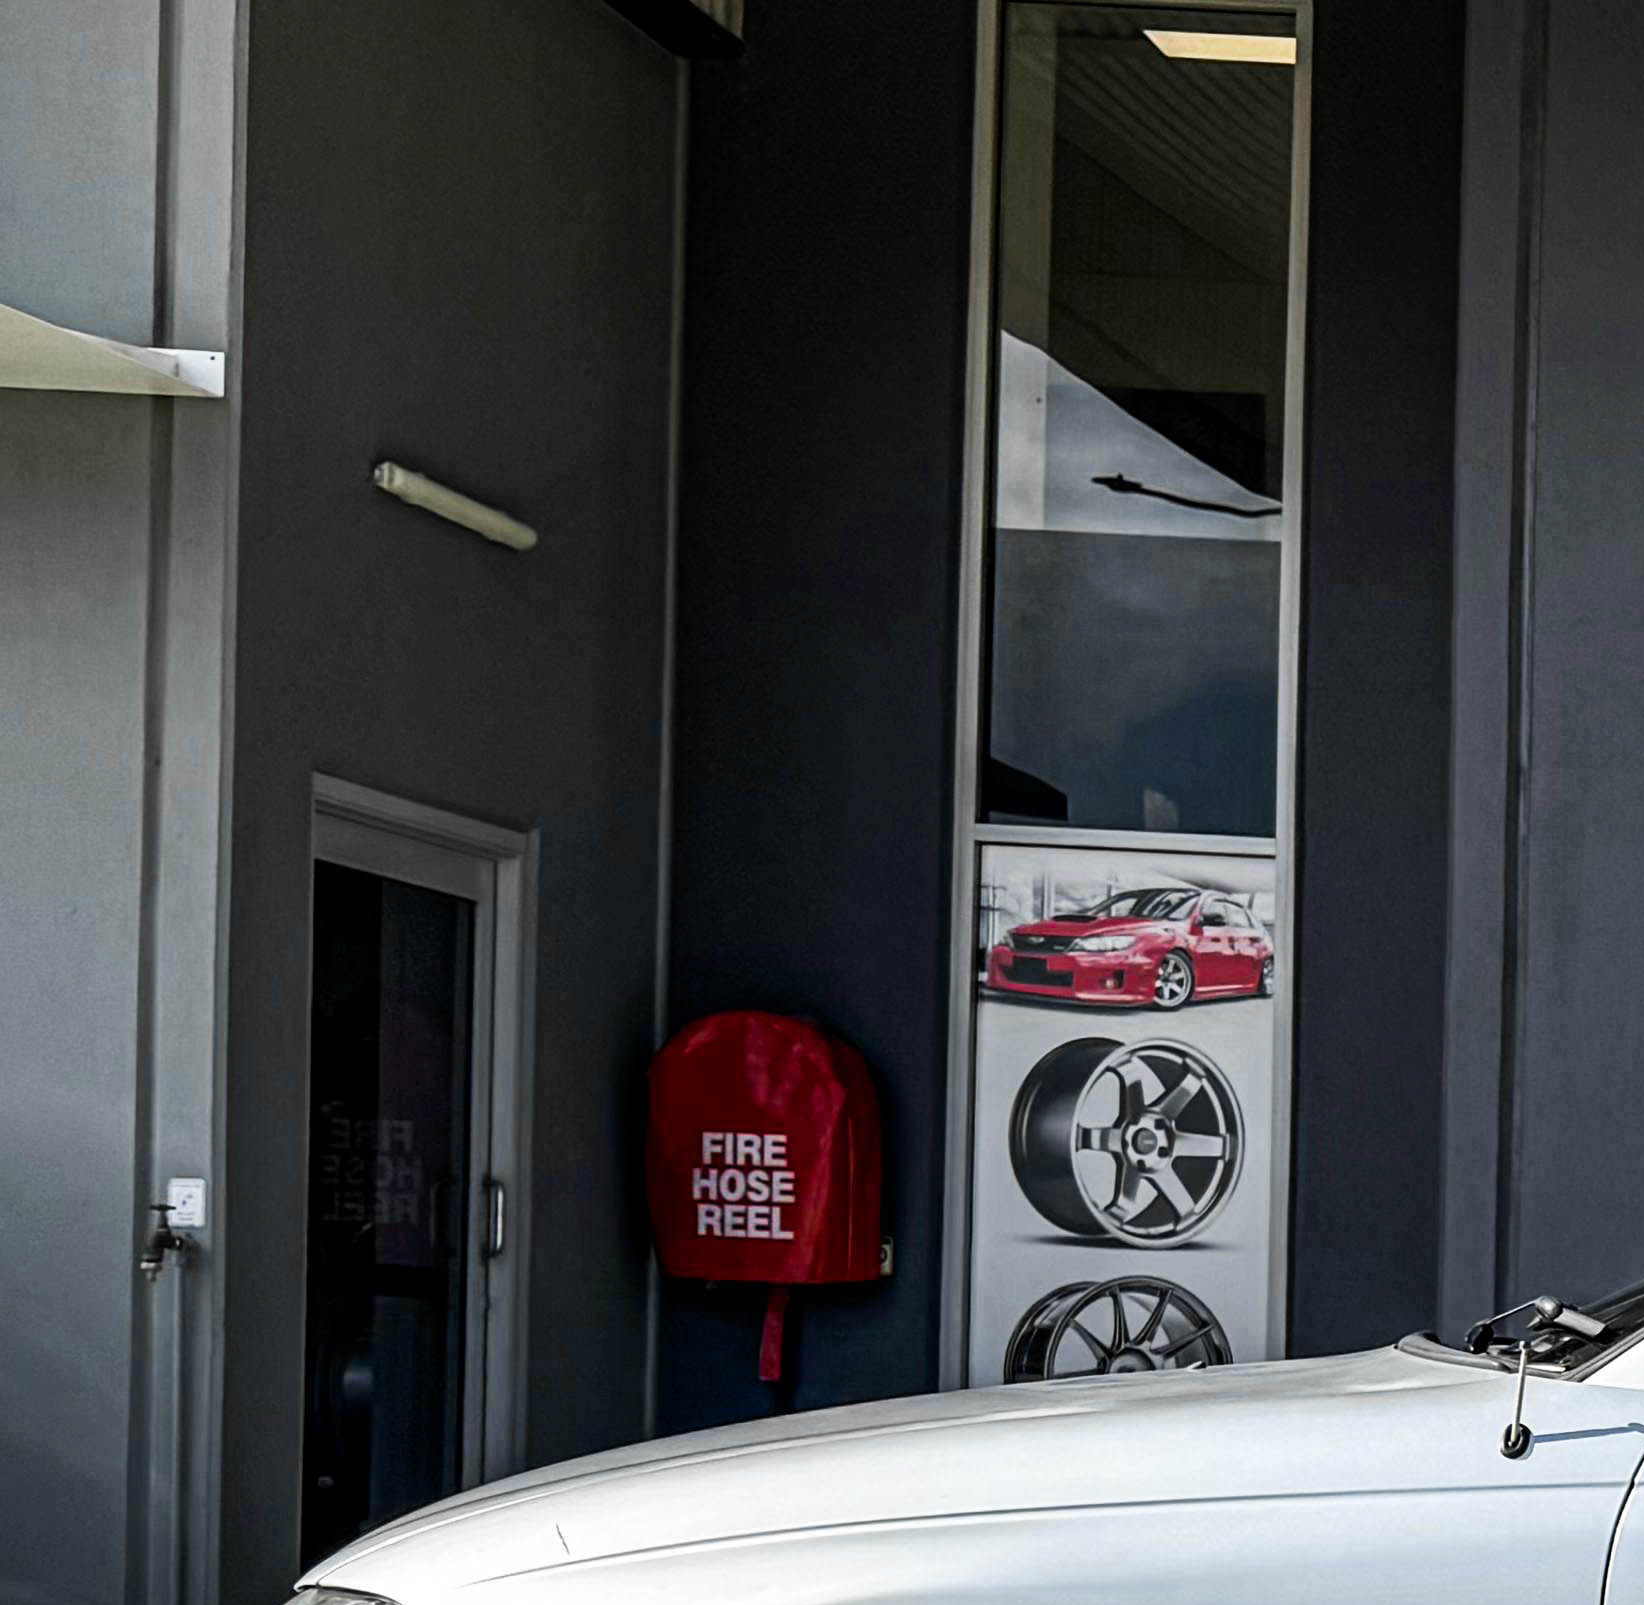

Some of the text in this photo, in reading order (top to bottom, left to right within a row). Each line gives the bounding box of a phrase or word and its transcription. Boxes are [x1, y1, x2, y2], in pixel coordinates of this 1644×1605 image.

[702, 1132, 787, 1167] FIRE
[692, 1167, 795, 1203] HOSE
[697, 1203, 794, 1240] REEL
